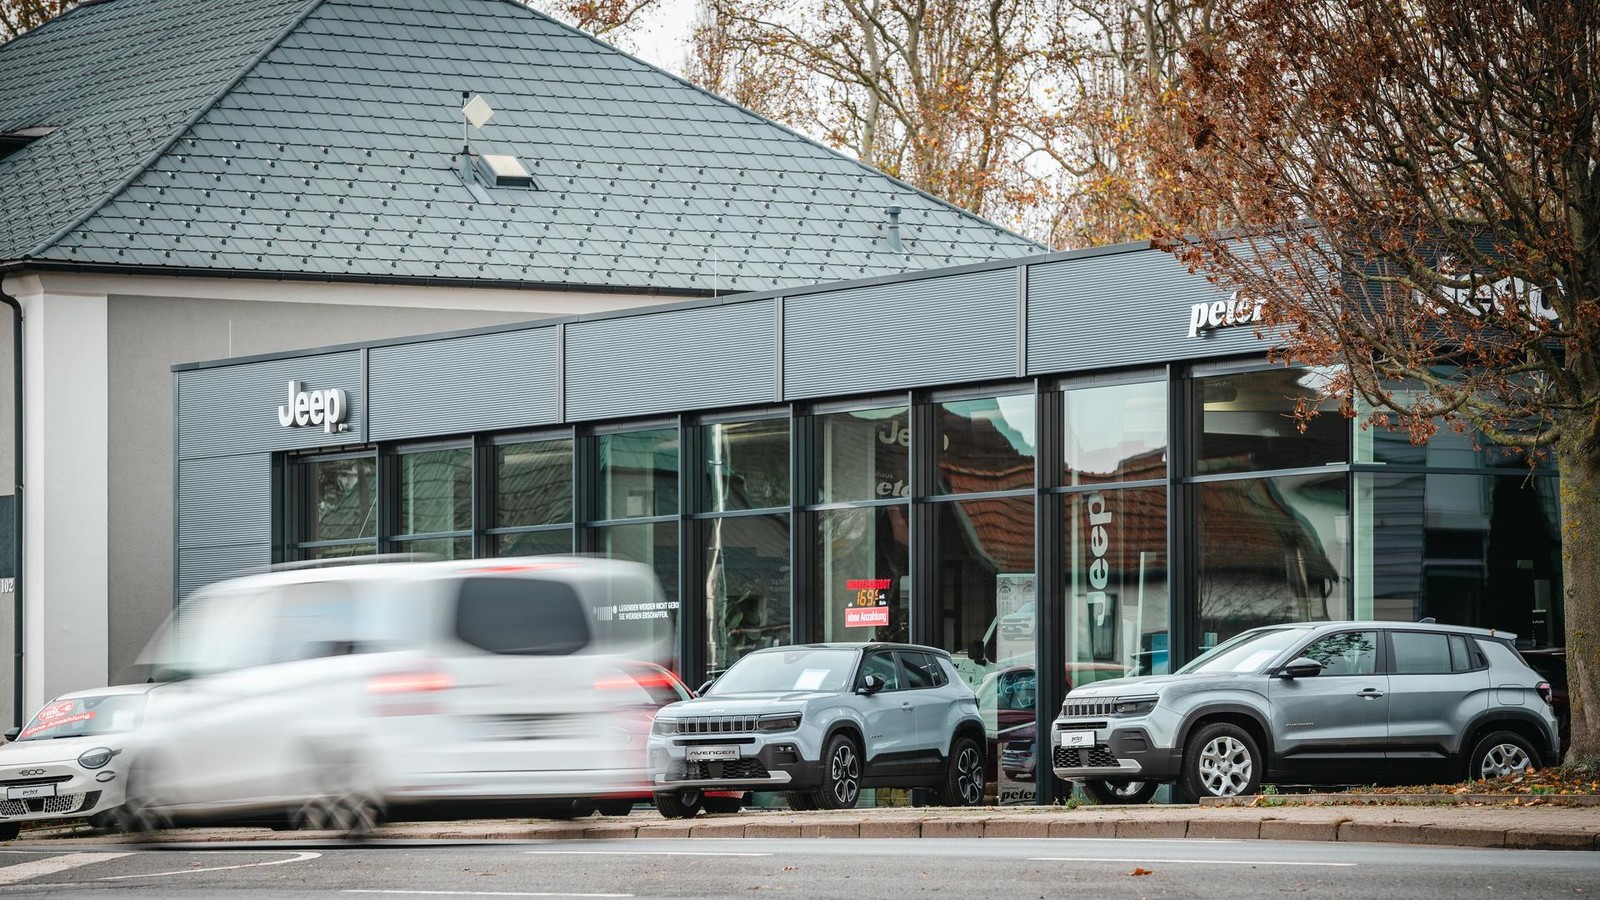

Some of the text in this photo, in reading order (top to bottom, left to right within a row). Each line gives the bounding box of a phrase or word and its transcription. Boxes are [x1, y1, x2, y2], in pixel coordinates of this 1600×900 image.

[1187, 291, 1267, 337] peter
[278, 380, 349, 433] Jeep
[1086, 492, 1112, 627] Jeep
[1, 578, 14, 593] 102
[640, 602, 655, 610] WERDEN
[626, 612, 641, 620] WERDEN
[848, 611, 887, 623] ohne Anzahlung
[26, 725, 46, 735] ohne
[47, 714, 90, 728] Anzahlung
